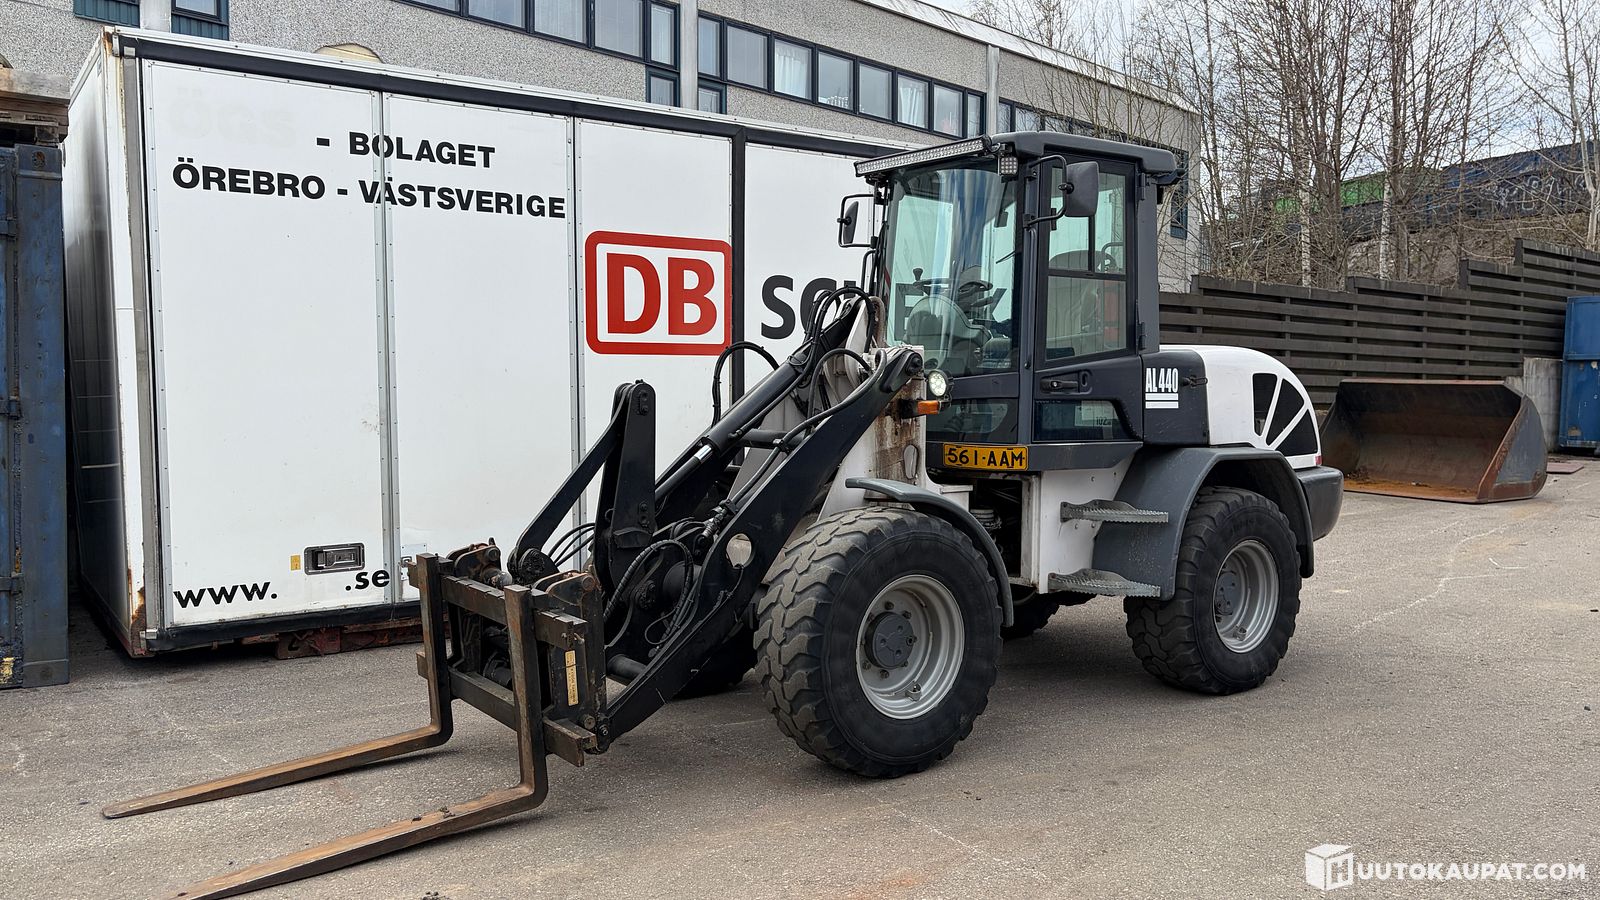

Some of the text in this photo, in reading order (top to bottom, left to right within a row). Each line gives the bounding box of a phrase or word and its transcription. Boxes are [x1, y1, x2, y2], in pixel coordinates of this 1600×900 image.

[349, 132, 496, 168] BOLAGET
[172, 157, 326, 199] ÖREBRO
[358, 176, 566, 219] VÄSTSVERIGE
[606, 252, 717, 336] DB
[947, 447, 1023, 467] 561-AAM
[173, 568, 390, 609] www. .se
